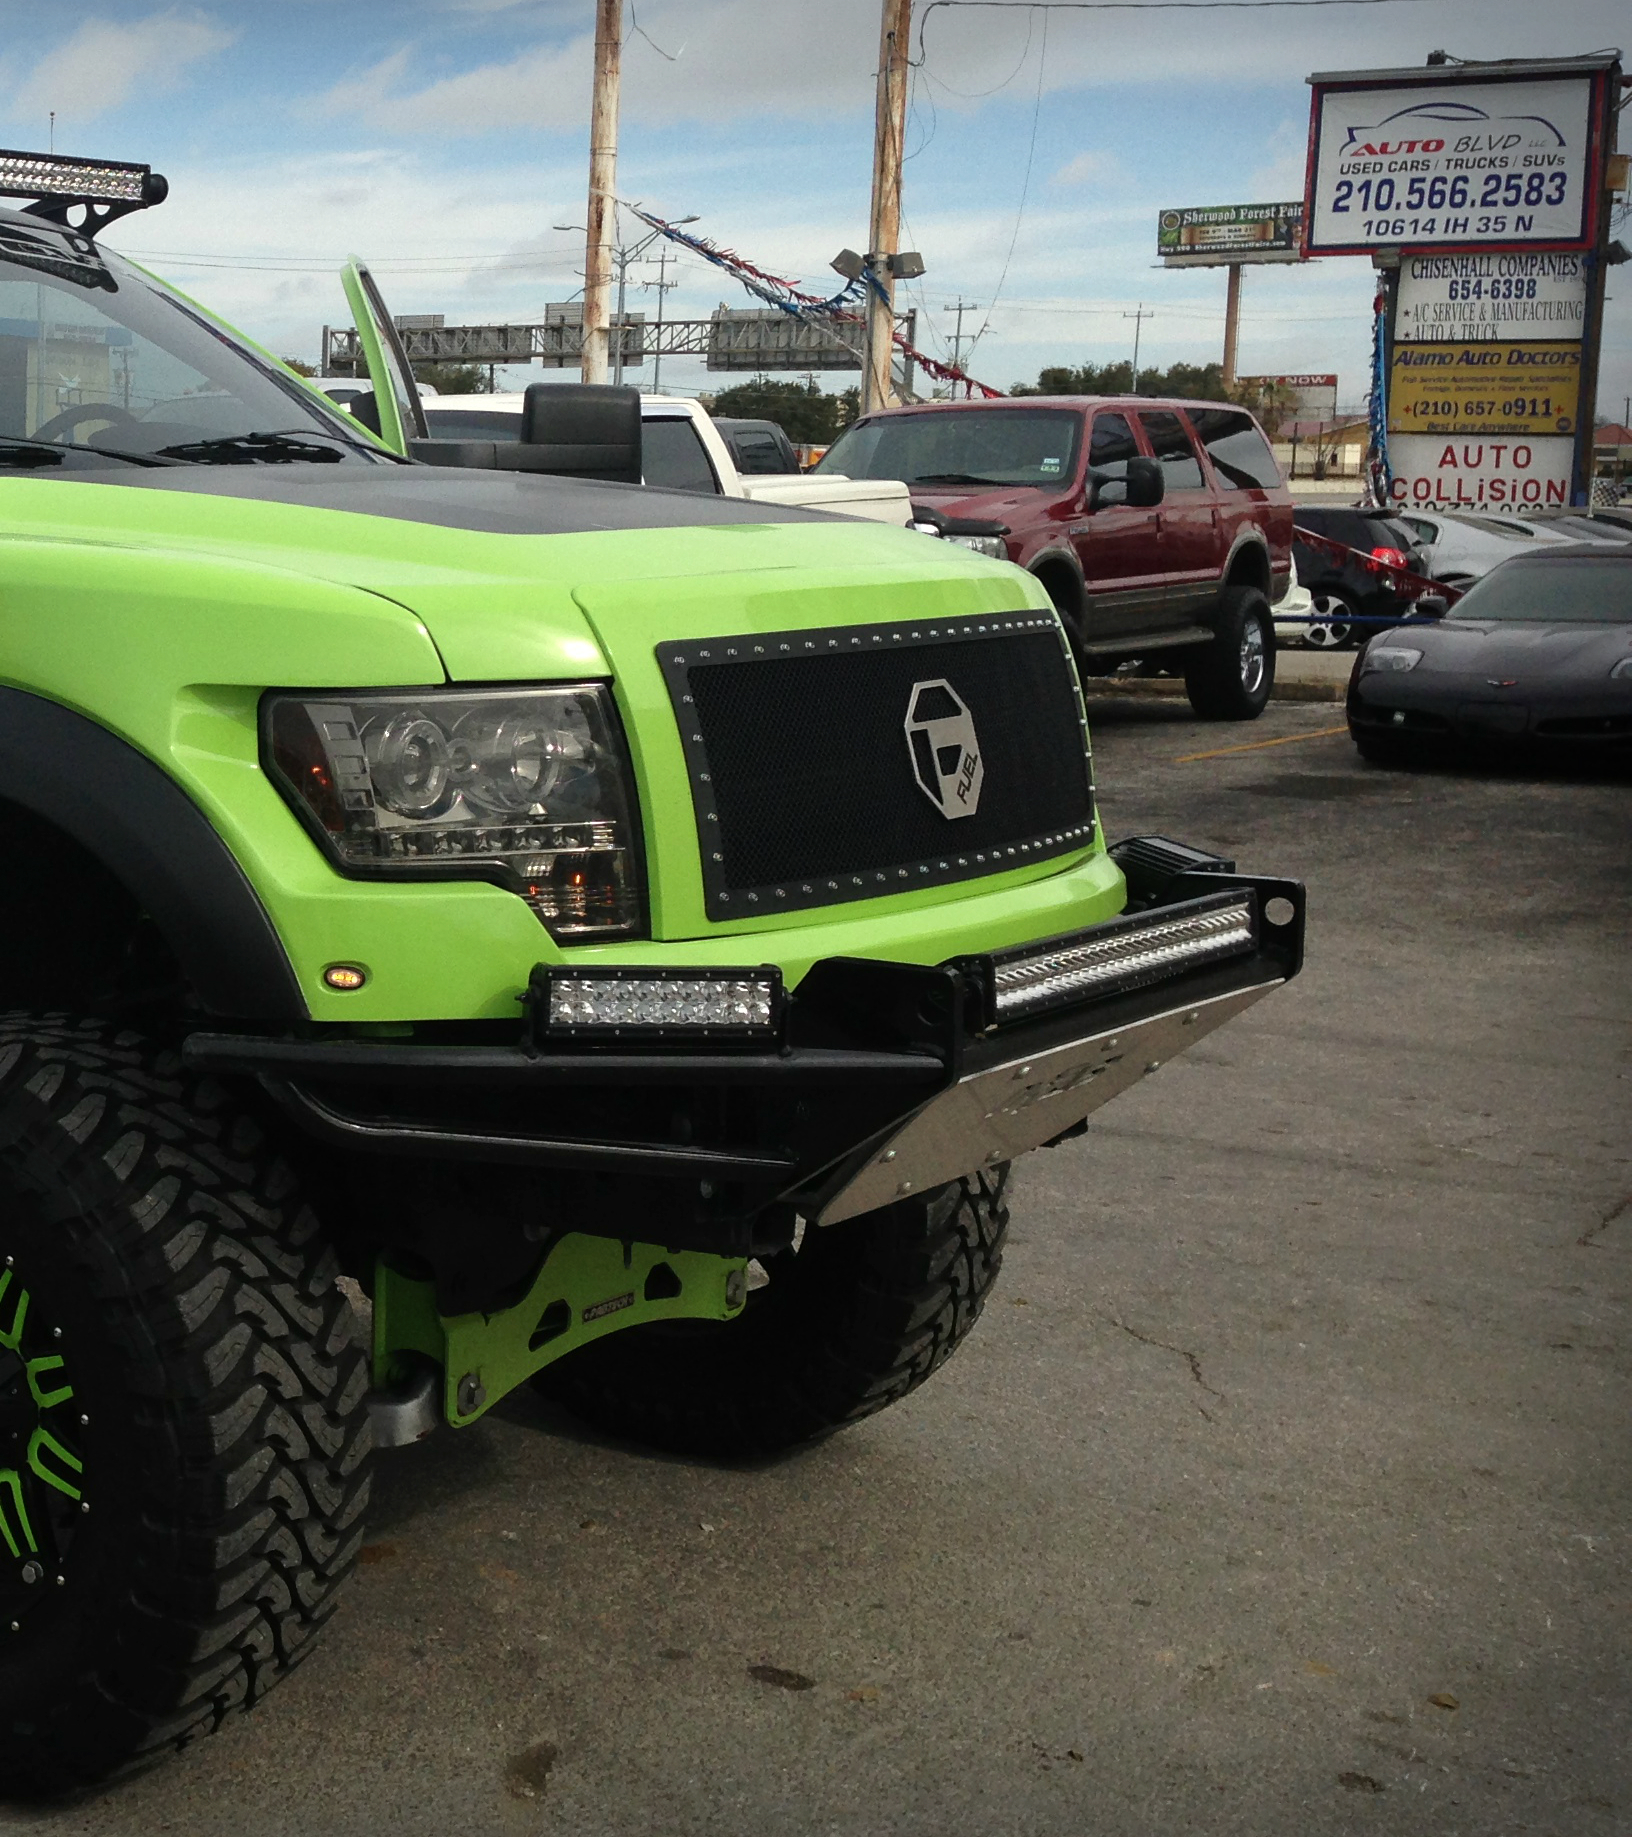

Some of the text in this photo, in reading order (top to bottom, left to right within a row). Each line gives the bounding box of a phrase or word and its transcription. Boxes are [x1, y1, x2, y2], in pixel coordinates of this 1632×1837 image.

[1350, 138, 1445, 157] AUTO
[1453, 134, 1522, 153] BLVD
[1339, 161, 1383, 175] USED
[1388, 159, 1431, 173] CARS
[1444, 156, 1510, 171] TRUCKS
[1522, 154, 1566, 168] SUVs
[1331, 171, 1568, 213] 210.566.2583
[1183, 208, 1237, 225] Sherwood
[1239, 206, 1277, 221] Forest
[1362, 215, 1534, 237] 10614 IH 35 N
[1498, 254, 1579, 278] COMPANIES
[1448, 278, 1537, 301] 654-6398
[1413, 300, 1584, 323] A/C SERVICE & MANUFACTURING
[1414, 323, 1500, 341] AUTO & TRUCK
[1394, 349, 1580, 367] Alamo Auto Doctors
[1285, 375, 1328, 385] NOW
[1412, 397, 1553, 418] (210) 657-0911
[1437, 444, 1532, 469] AUTO
[956, 752, 979, 805] FUEL
